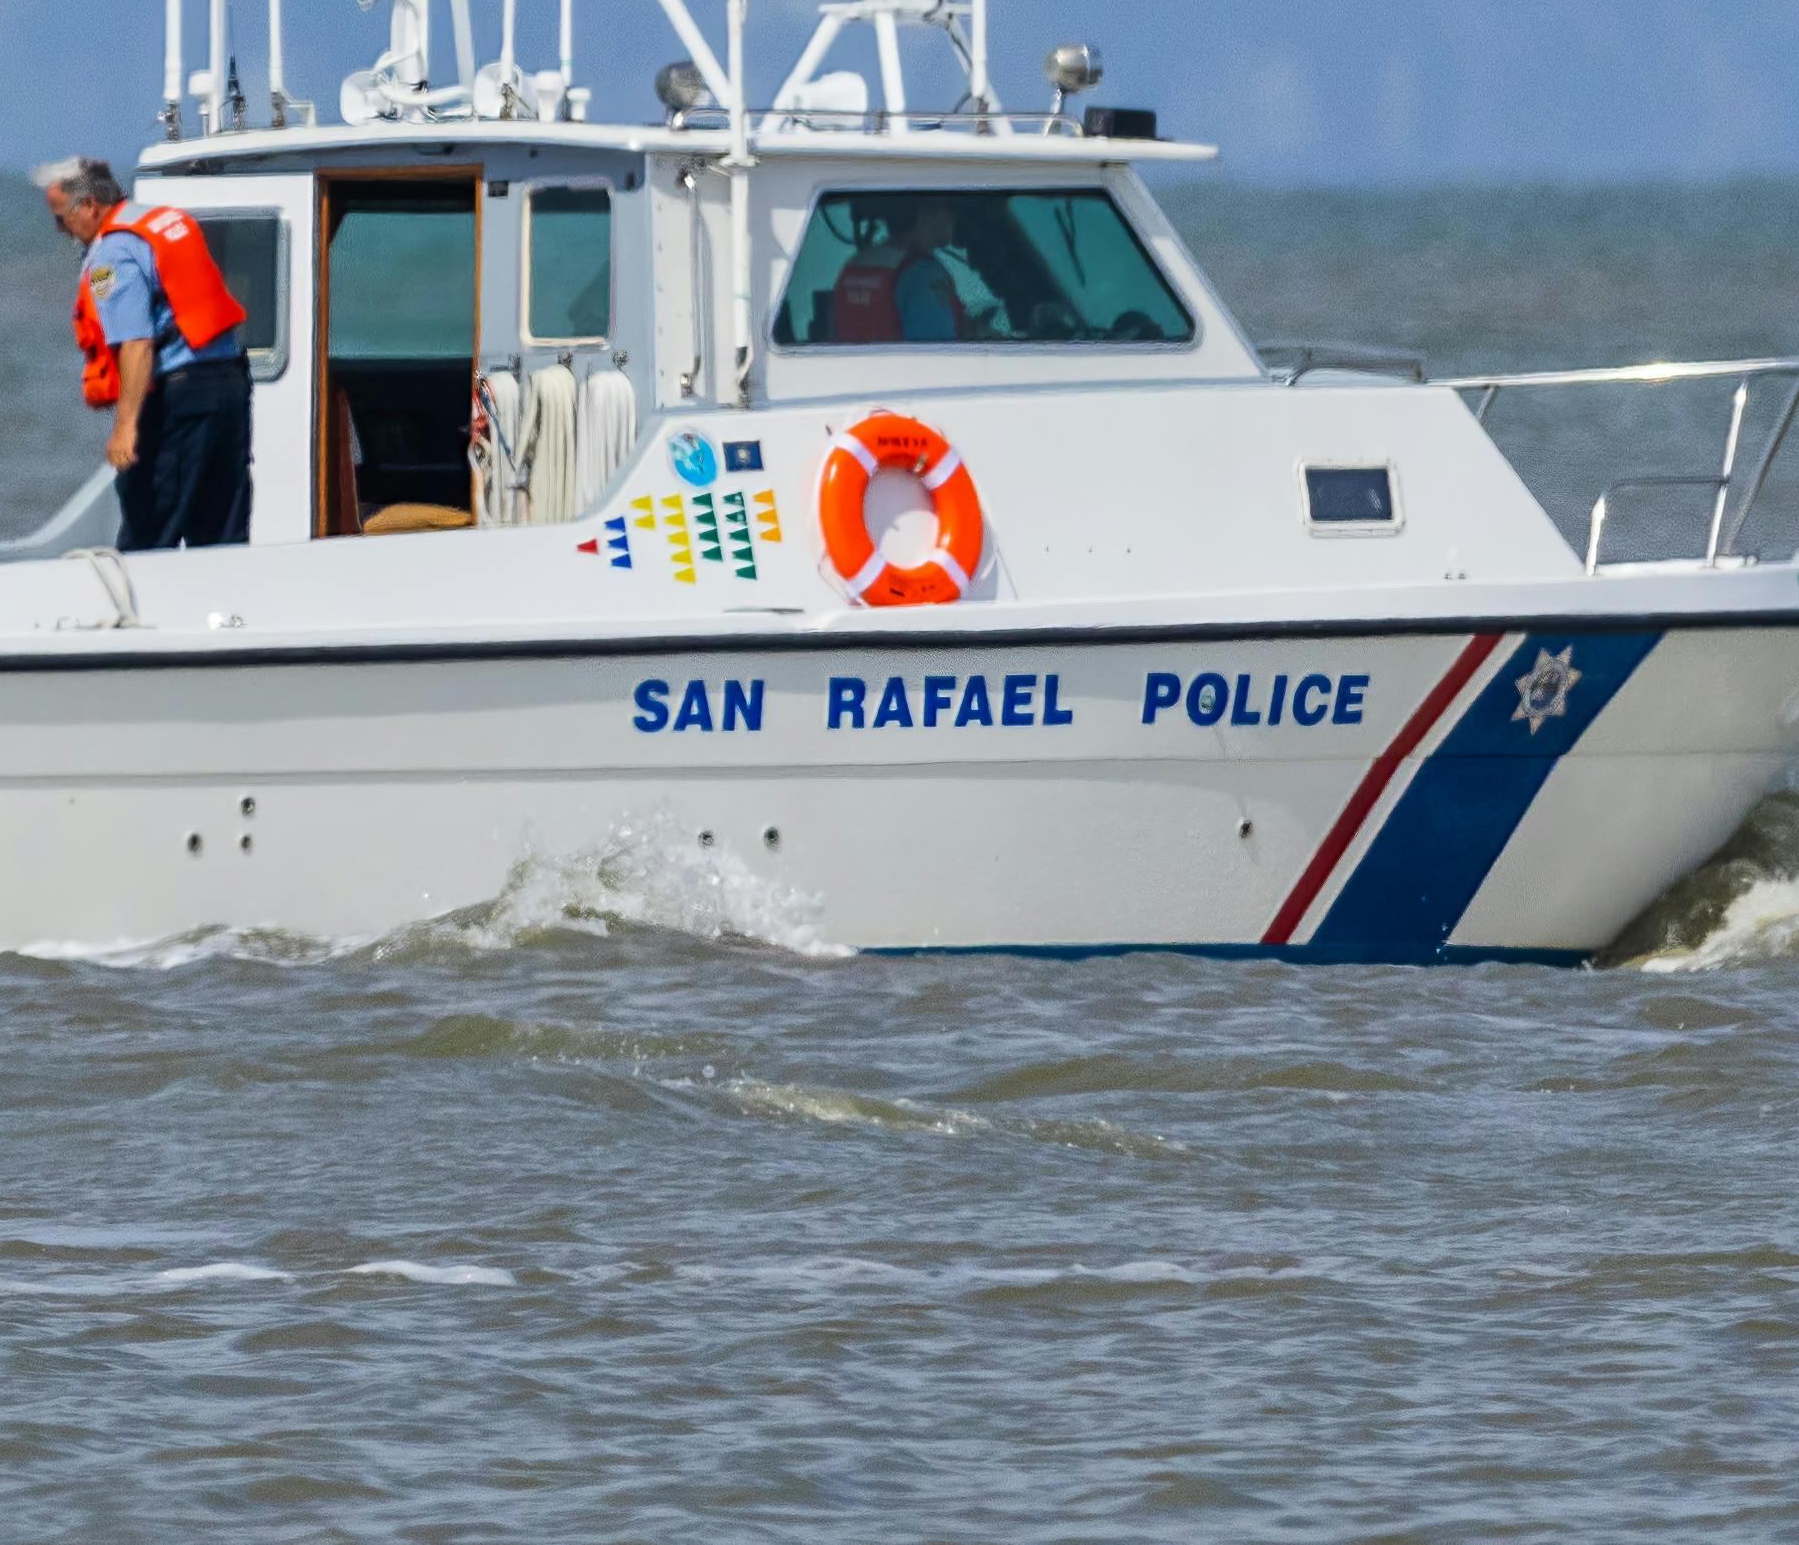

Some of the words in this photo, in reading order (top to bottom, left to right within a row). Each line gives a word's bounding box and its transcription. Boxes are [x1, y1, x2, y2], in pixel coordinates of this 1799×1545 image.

[632, 677, 766, 735] SAN
[827, 672, 1074, 731] RAFAEL
[1141, 671, 1371, 727] POLICE
